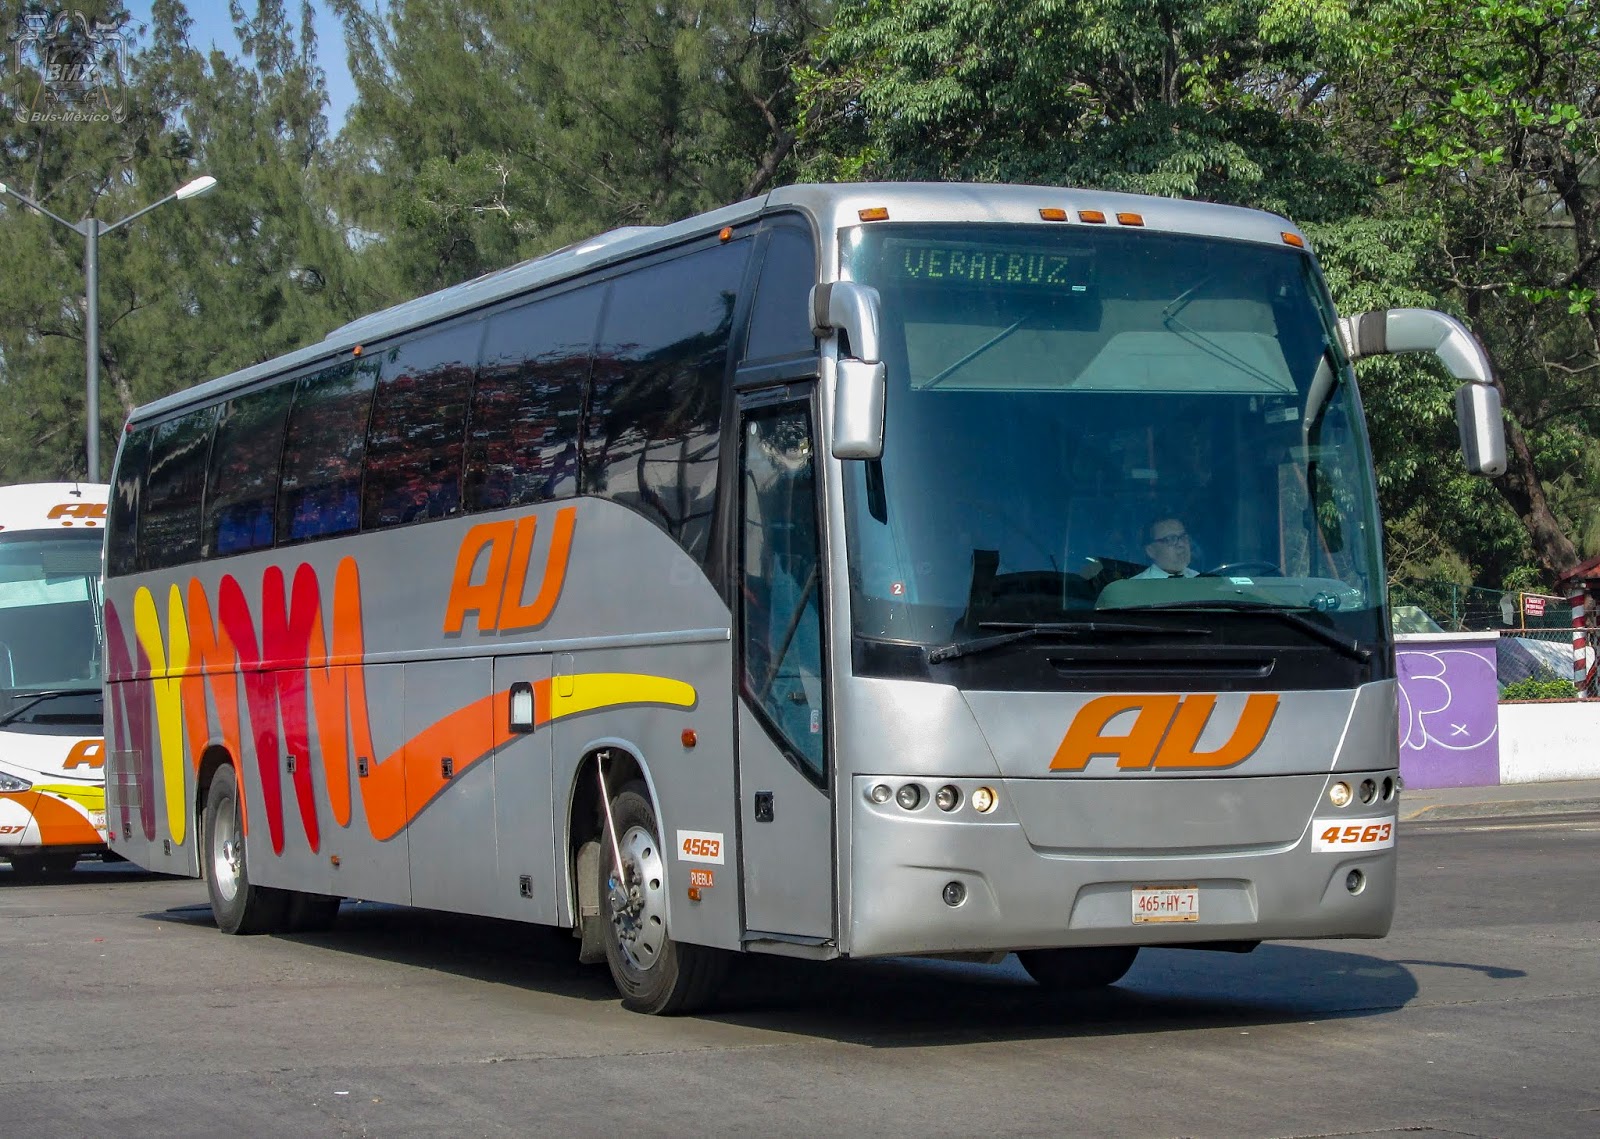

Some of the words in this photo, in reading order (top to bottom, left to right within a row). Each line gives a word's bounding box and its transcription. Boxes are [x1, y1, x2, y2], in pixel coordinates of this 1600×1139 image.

[904, 249, 1068, 283] VERACRUZ
[443, 506, 577, 638] AU
[894, 583, 902, 595] 2
[1048, 693, 1280, 772] AU
[1320, 823, 1392, 844] 4563
[683, 838, 720, 857] 4563
[690, 872, 714, 887] PUEBLA
